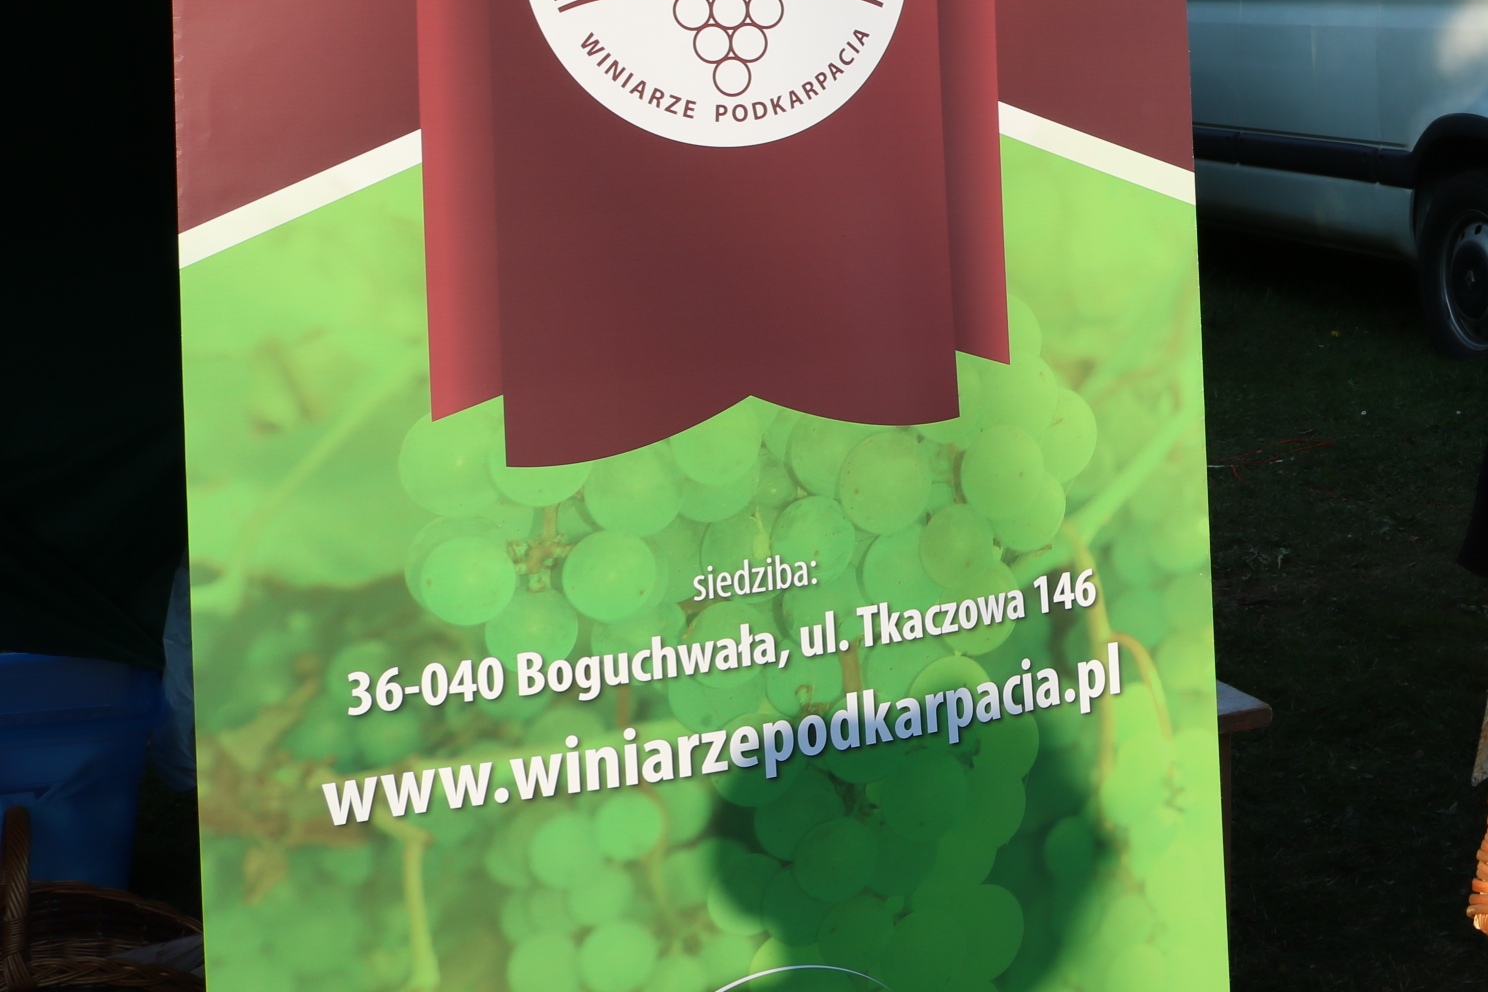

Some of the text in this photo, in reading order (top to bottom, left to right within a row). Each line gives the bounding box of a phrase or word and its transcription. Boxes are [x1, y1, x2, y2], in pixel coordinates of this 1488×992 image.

[580, 27, 871, 123] WINIARZE PODKARPACIA
[693, 557, 819, 602] siedziba:
[347, 567, 1097, 717] 36-040 Boguchwała, ul. Tkaczowa 146
[321, 643, 1123, 827] www.winiarzepodkarpacia.pl
